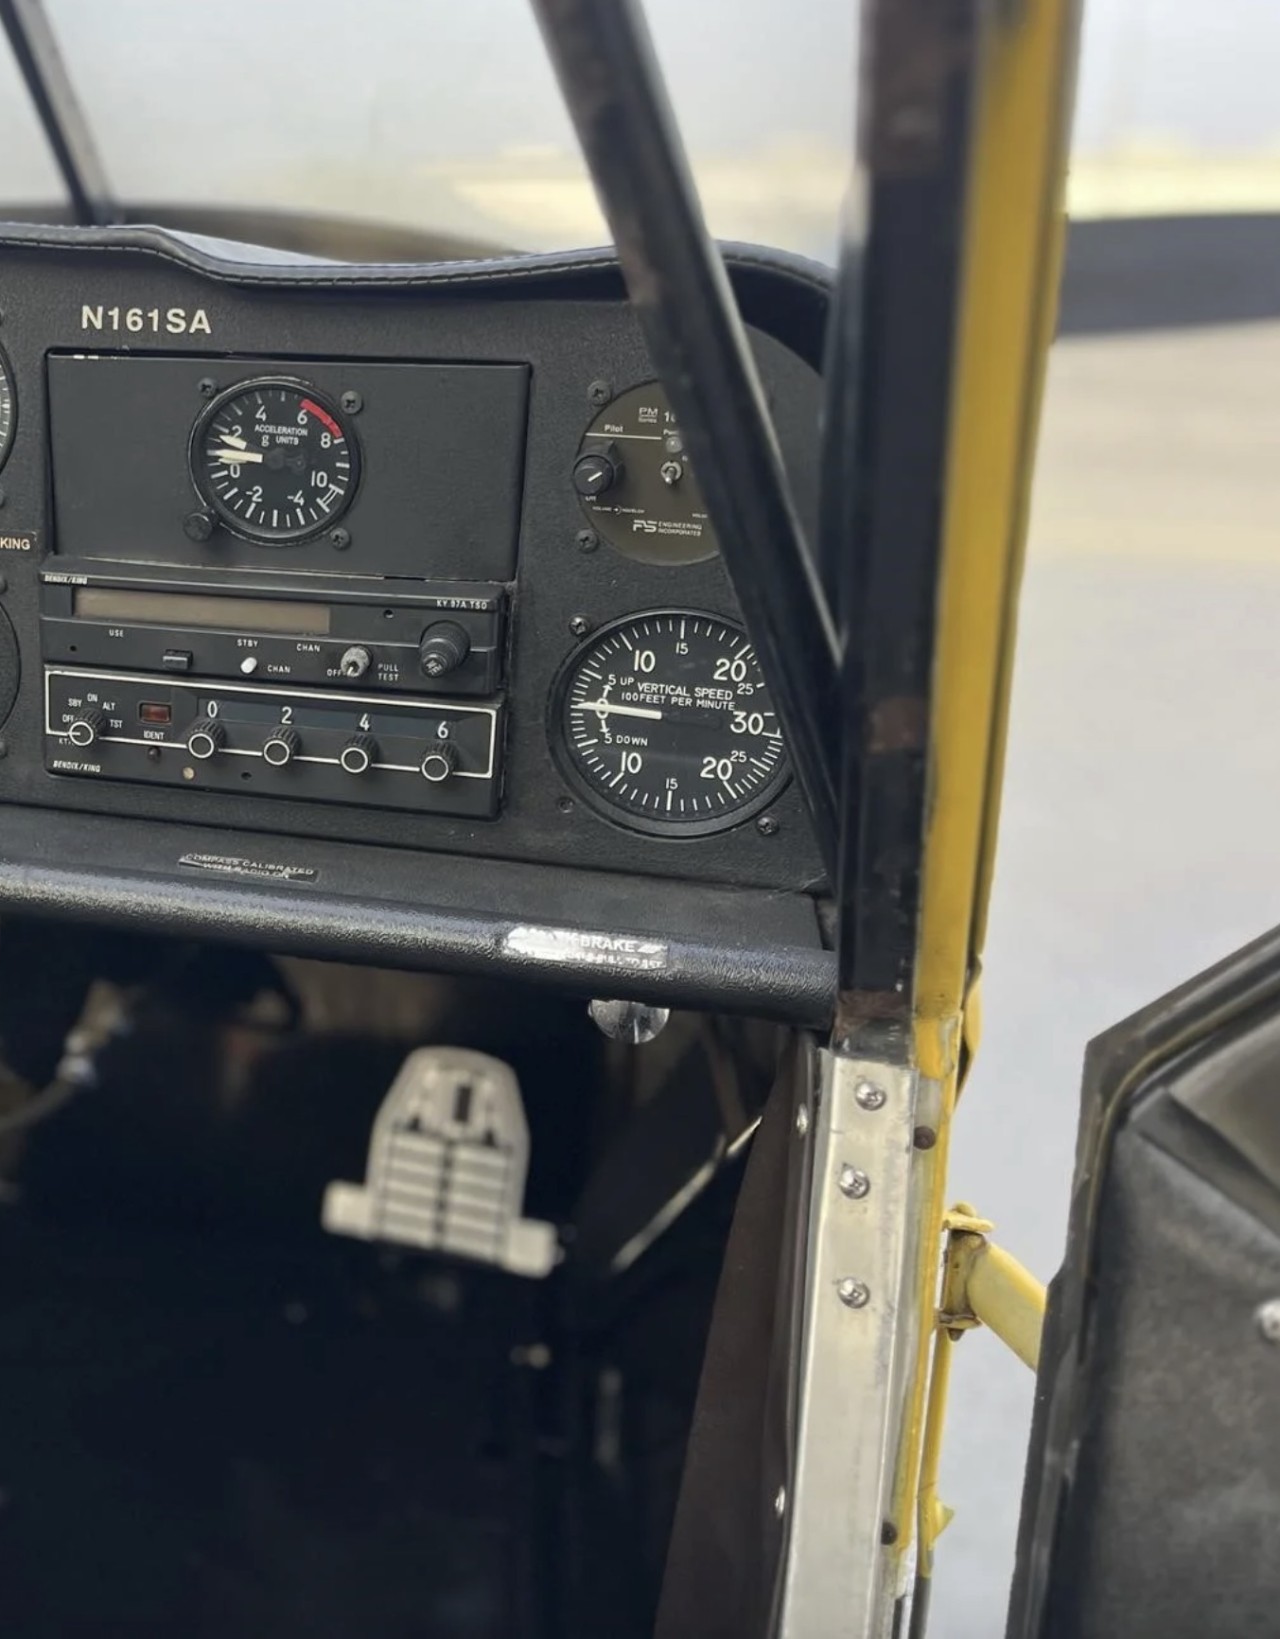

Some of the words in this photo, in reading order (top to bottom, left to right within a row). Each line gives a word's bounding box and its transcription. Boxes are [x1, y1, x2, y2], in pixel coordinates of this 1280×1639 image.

[81, 305, 212, 334] N161SA
[256, 405, 267, 421] 4
[297, 409, 308, 424] 6
[639, 407, 658, 416] PM
[232, 425, 243, 439] 2
[254, 424, 308, 437] ACCELERATION
[604, 424, 624, 433] Pilot
[262, 435, 269, 447] g
[275, 436, 299, 445] UNITS
[321, 432, 331, 448] 8
[230, 464, 240, 479] 0
[311, 470, 328, 488] 10
[245, 486, 263, 502] -2
[287, 490, 305, 506] -4
[658, 521, 702, 531] ENGINEERING
[44, 574, 88, 585] BENDIX/KING
[470, 601, 488, 610] TSO
[109, 629, 124, 638] USE
[237, 639, 258, 648] STBY
[297, 643, 321, 652] CHAN
[675, 642, 689, 655] 15
[378, 663, 399, 672] PULL
[634, 650, 656, 673] 10
[267, 664, 291, 674] CHAN
[327, 668, 342, 677] OFF
[713, 658, 747, 682] 20
[378, 672, 399, 682] TEST
[608, 674, 616, 685] 5
[620, 676, 634, 686] UP
[637, 682, 690, 697] VERTICAL
[694, 687, 733, 701] SPEED
[737, 683, 754, 695] 25
[68, 698, 83, 708] SBY
[87, 693, 98, 703] ON
[671, 696, 692, 707] PER
[696, 698, 736, 711] MINUTE
[102, 701, 116, 711] ALT
[207, 700, 218, 718] 0
[281, 706, 293, 724] 2
[110, 719, 123, 729] TST
[359, 713, 370, 731] 4
[730, 710, 764, 735] 30
[143, 730, 164, 741] IDENT
[437, 721, 449, 739] 6
[604, 733, 612, 744] 5
[616, 735, 648, 746] DOWN
[622, 751, 642, 774] 10
[730, 750, 747, 763] 25
[53, 760, 101, 773] BENDIX/KING
[700, 756, 733, 781] 20
[665, 778, 678, 790] 15
[242, 860, 314, 875] CALIBRATED
[581, 934, 640, 952] BRAKE
